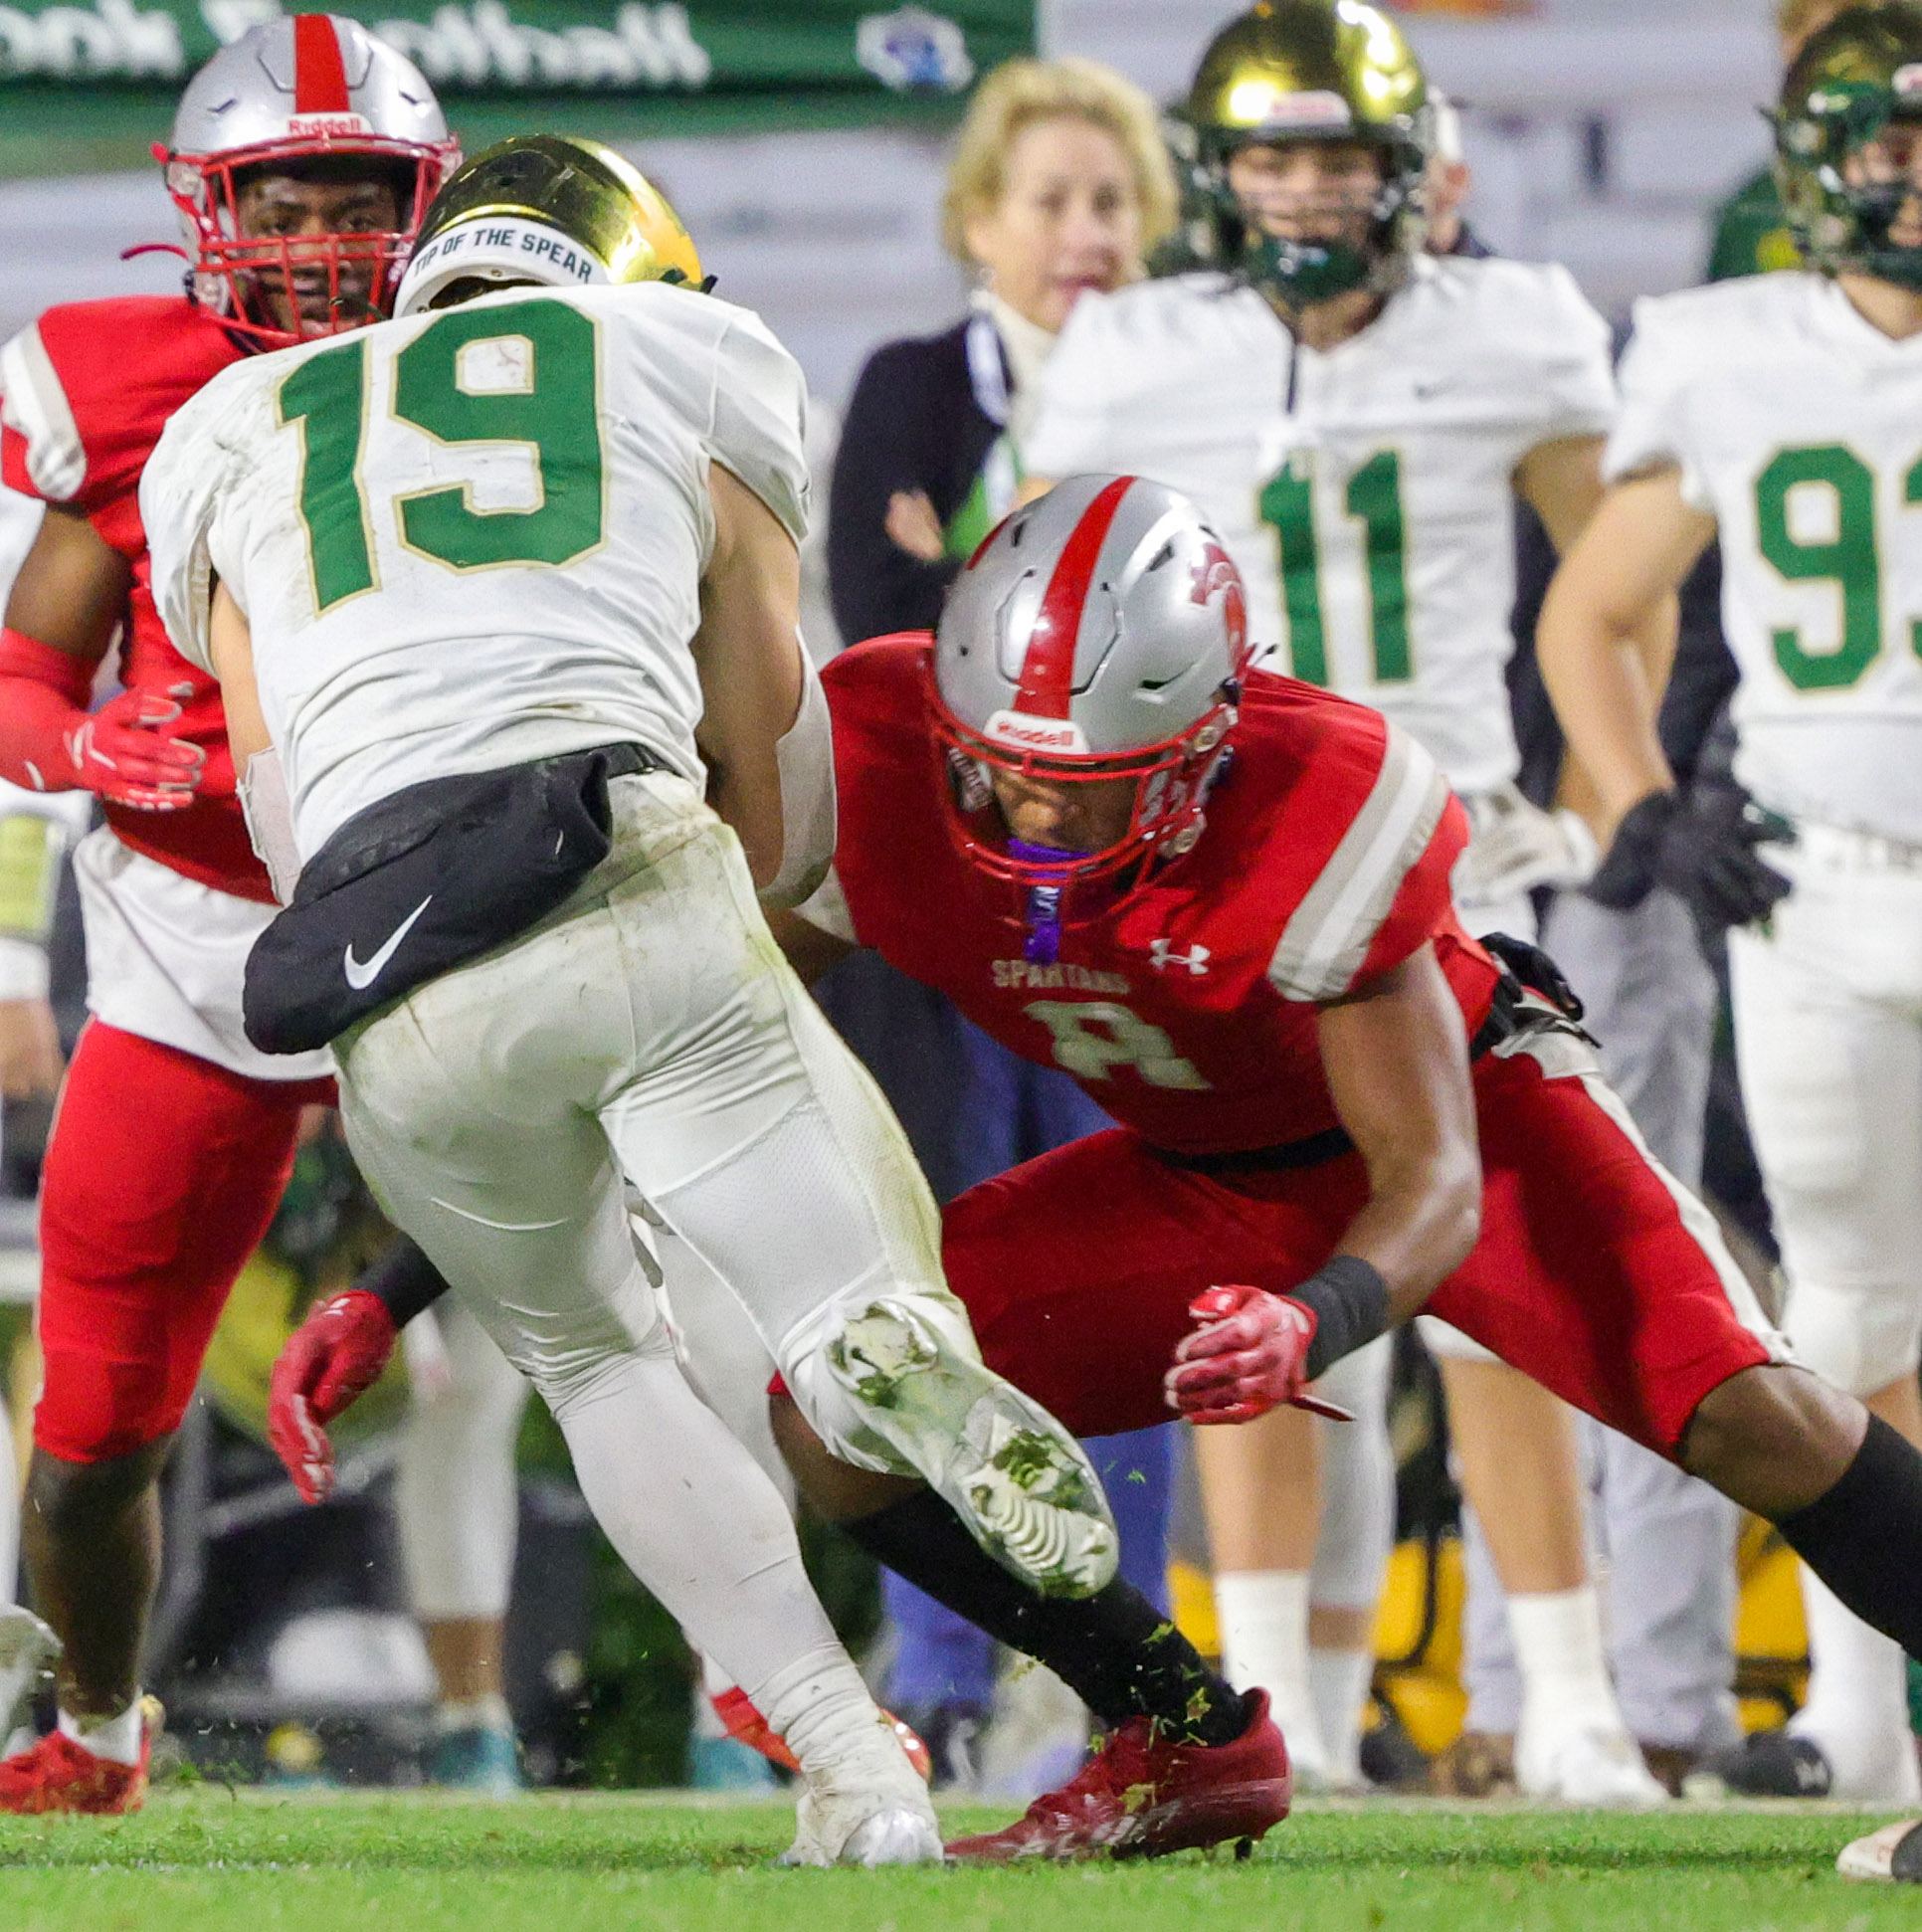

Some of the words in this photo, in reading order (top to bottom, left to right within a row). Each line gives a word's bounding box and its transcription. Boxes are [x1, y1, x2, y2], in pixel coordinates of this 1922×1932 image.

[414, 245, 439, 277] TIP
[442, 231, 468, 257] OF
[473, 228, 516, 248] THE
[520, 232, 593, 285] SPEAR
[273, 296, 611, 621] 19
[1255, 447, 1415, 688] 11
